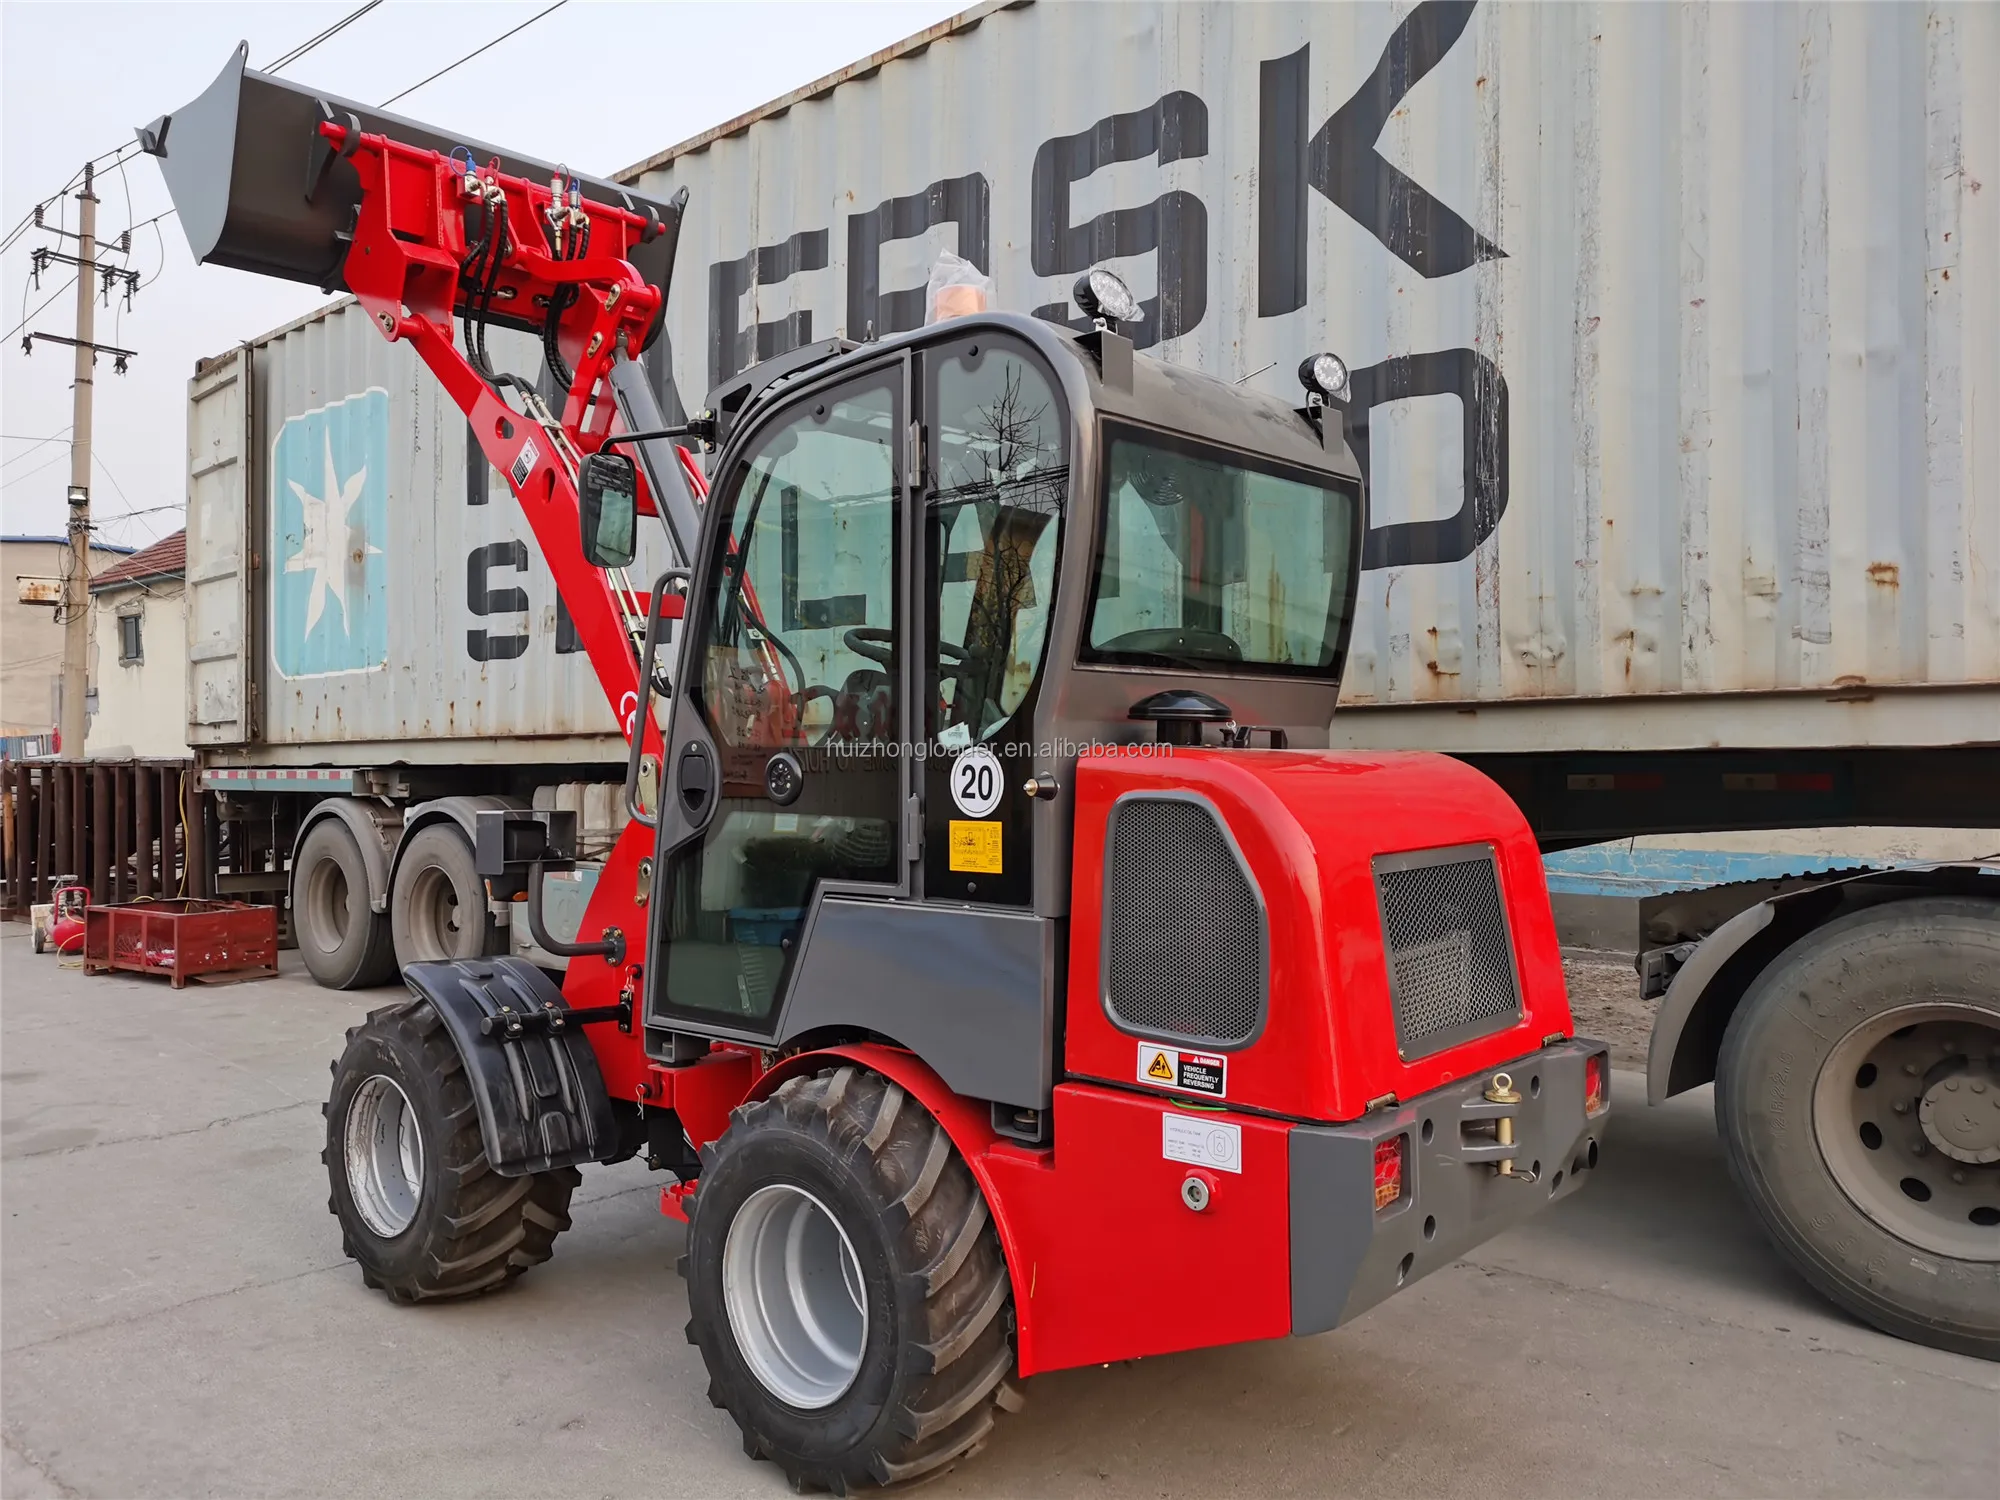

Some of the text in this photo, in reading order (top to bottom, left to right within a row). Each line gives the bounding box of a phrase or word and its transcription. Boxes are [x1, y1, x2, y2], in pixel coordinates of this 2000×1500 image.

[961, 764, 993, 801] 20
[1200, 1057, 1221, 1067] DANGER
[1183, 1064, 1207, 1075] VEHICLE
[1183, 1071, 1220, 1083] FREQUENTLY
[1183, 1079, 1215, 1090] REVERSING
